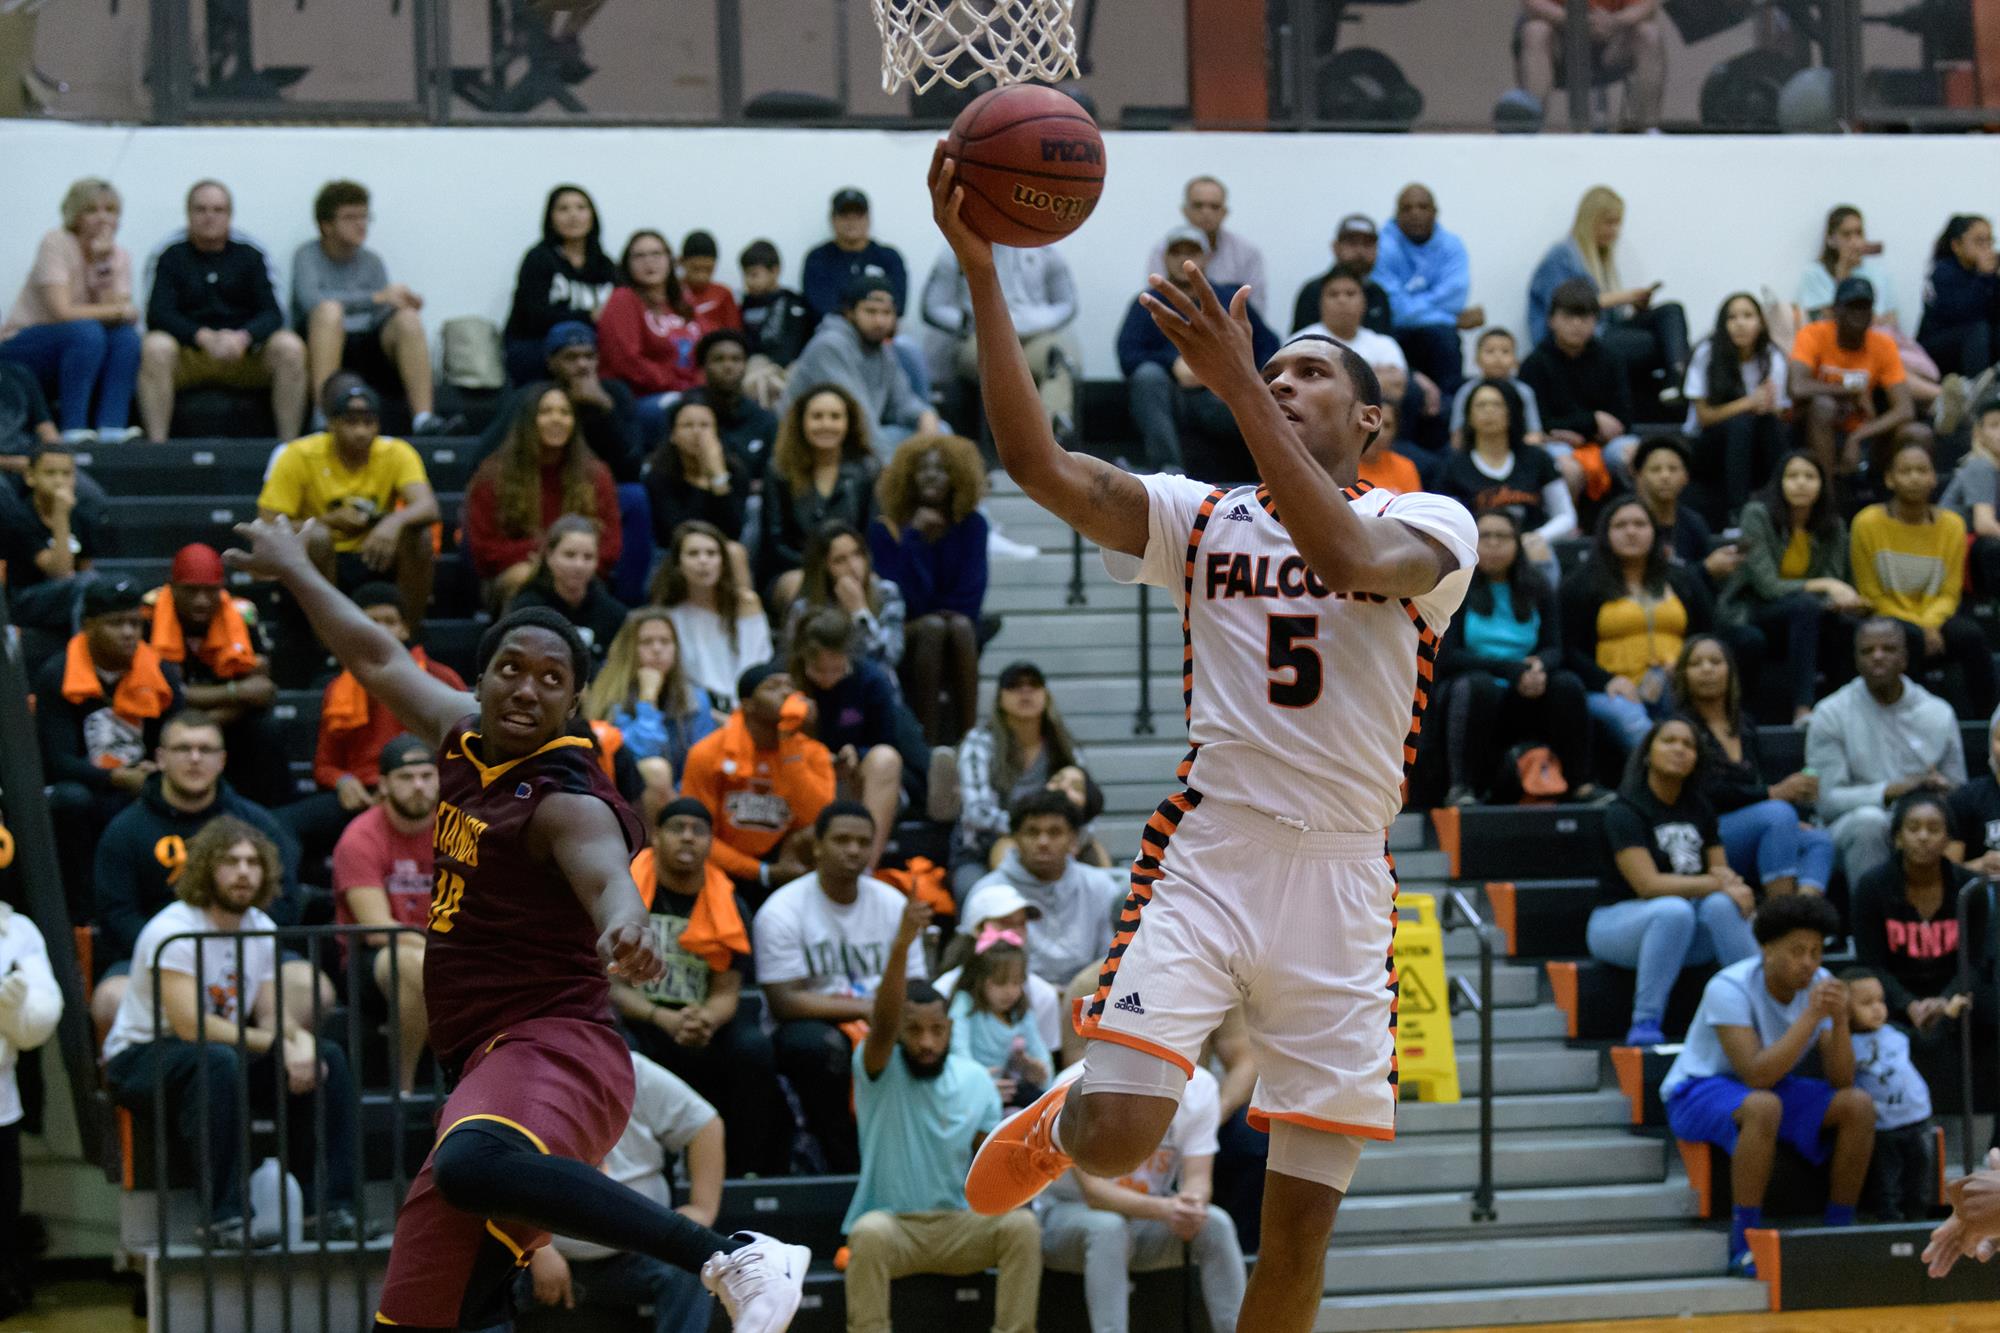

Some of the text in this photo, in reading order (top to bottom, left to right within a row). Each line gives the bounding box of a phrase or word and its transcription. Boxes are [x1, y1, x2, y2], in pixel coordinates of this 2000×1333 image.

[1041, 139, 1101, 165] NCAA
[1206, 551, 1389, 604] FALCO
[1266, 613, 1325, 709] 5
[1114, 1000, 1145, 1016] adidas
